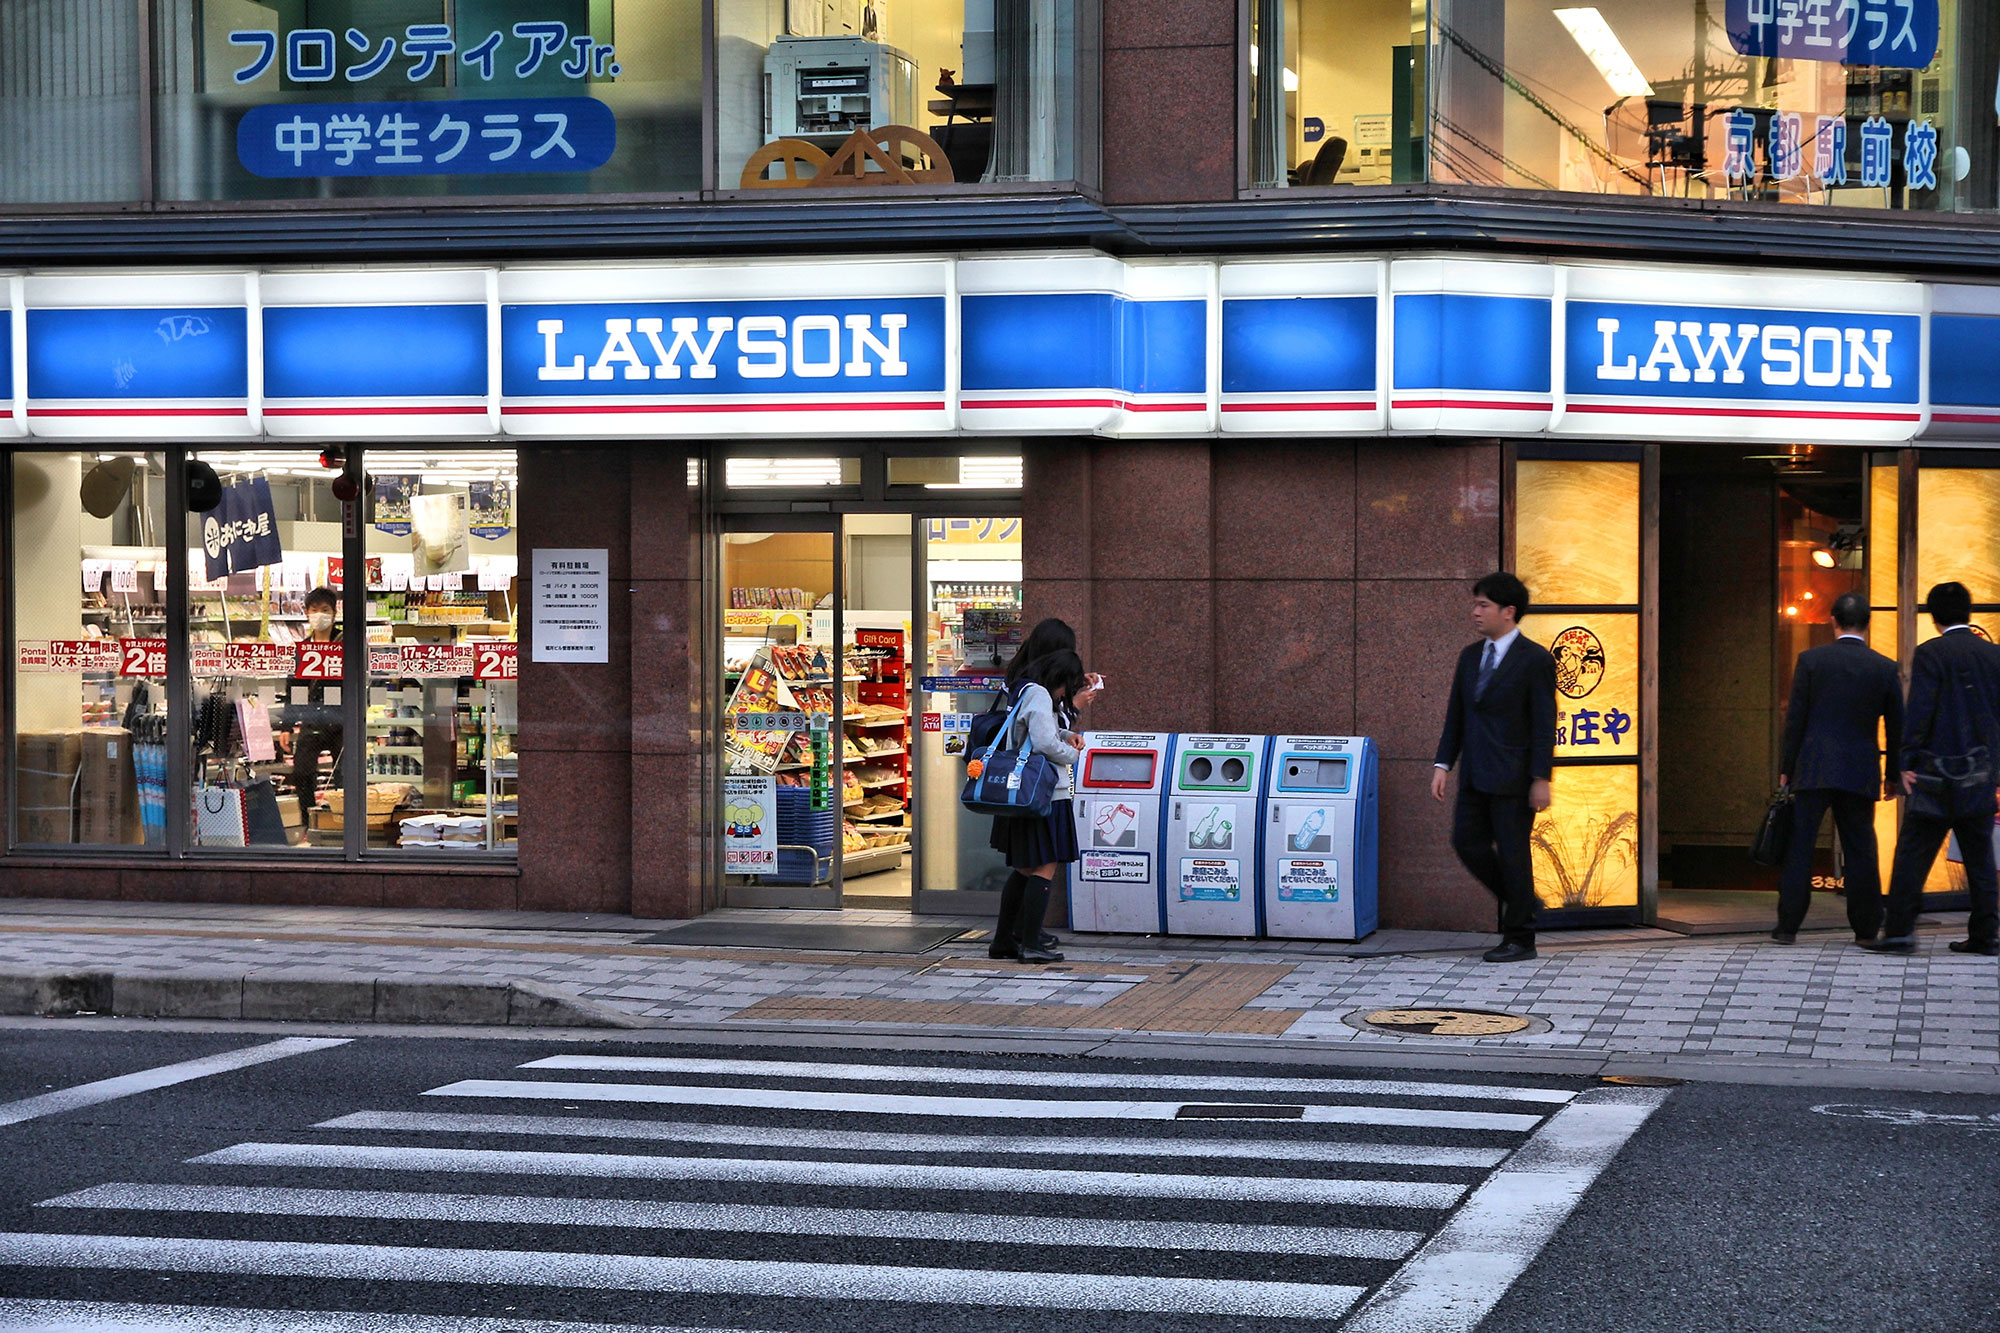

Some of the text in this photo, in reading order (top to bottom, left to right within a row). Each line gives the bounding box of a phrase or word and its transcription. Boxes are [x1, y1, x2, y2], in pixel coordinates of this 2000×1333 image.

[1747, 0, 1917, 52] 中学生クラス
[228, 21, 622, 85] フロンティアJr.
[275, 113, 576, 167] 中学生クラス
[1723, 108, 1937, 190] 京都駅前校
[537, 314, 907, 381] LAWSON
[1597, 318, 1893, 389] LAWSON
[21, 647, 47, 656] Ponta
[863, 634, 896, 644] Gift Card
[51, 655, 92, 668] 火・木・土
[126, 648, 166, 673] 2倍
[195, 650, 221, 658] Ponta
[226, 659, 267, 670] 火・木・土
[302, 651, 343, 677] 2倍
[371, 653, 398, 661] Ponta
[402, 660, 445, 672] 火・木・土
[480, 651, 518, 677] 2倍
[1570, 707, 1632, 746] 庄や
